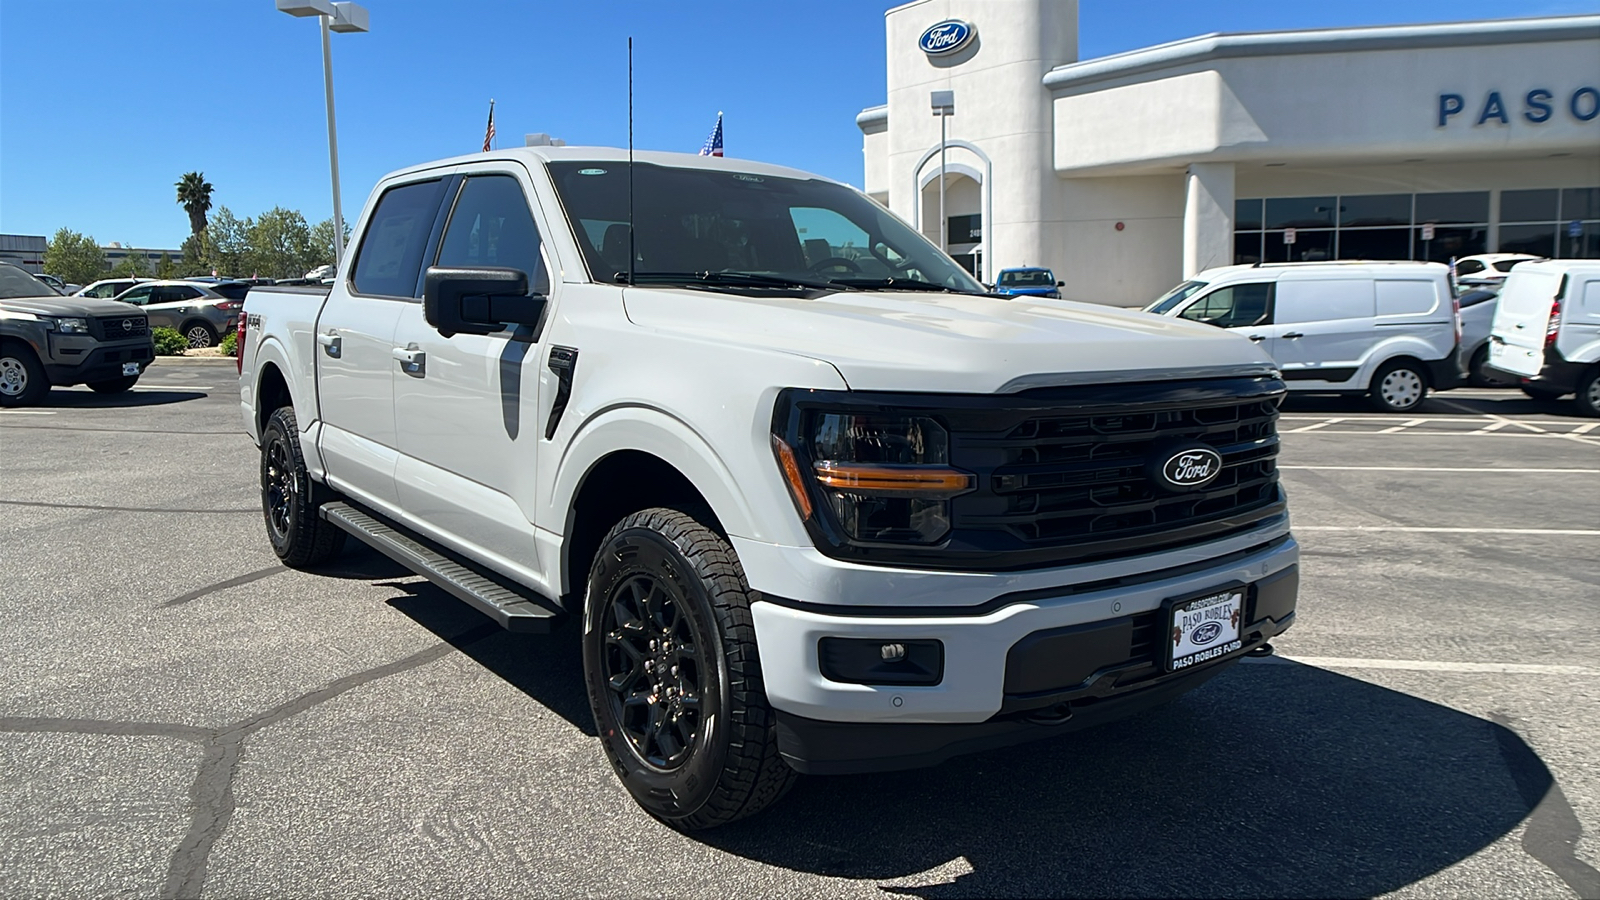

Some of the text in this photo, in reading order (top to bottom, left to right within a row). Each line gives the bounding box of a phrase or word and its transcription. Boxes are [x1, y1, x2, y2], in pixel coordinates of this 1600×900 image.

[927, 25, 959, 48] Ford
[1438, 87, 1600, 127] PASO
[1175, 454, 1211, 480] Ford
[1182, 603, 1232, 634] PASO ROBLES
[1196, 625, 1218, 642] Ford
[1173, 656, 1193, 670] PASO
[1195, 647, 1222, 663] ROBLES
